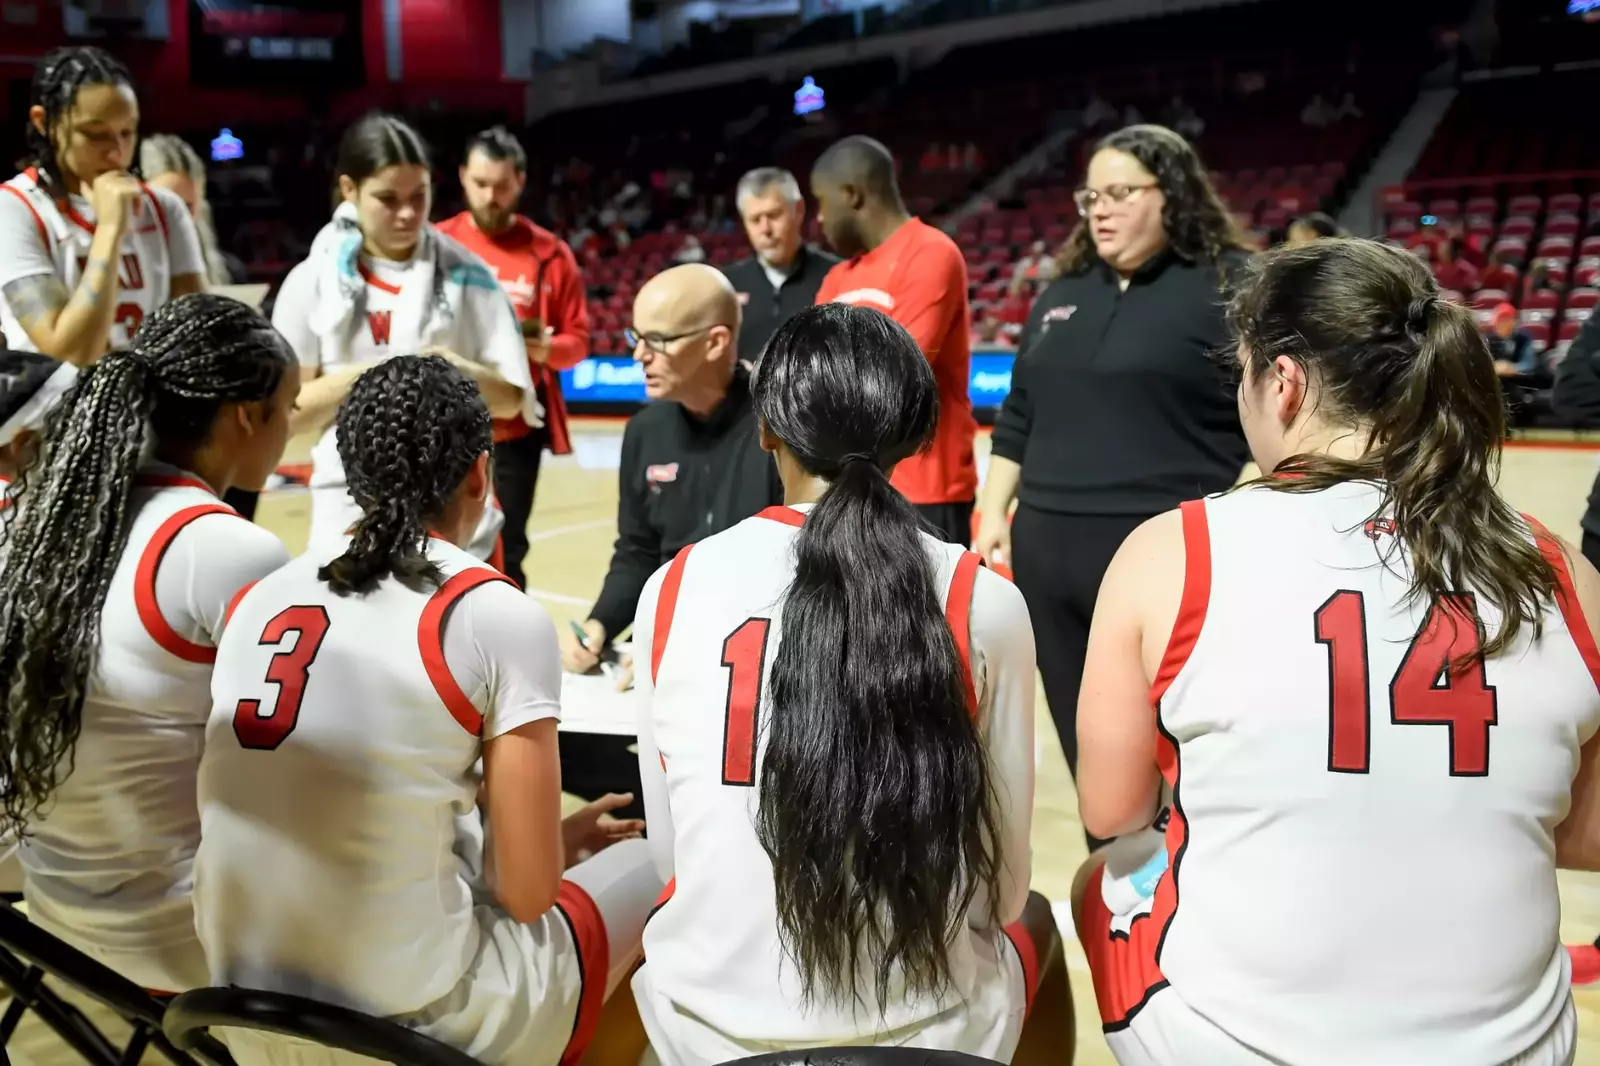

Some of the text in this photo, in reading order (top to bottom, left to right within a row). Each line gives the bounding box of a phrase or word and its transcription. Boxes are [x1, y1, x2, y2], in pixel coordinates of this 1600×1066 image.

[233, 605, 331, 750] 3
[720, 616, 771, 787] 1
[1314, 589, 1498, 777] 14
